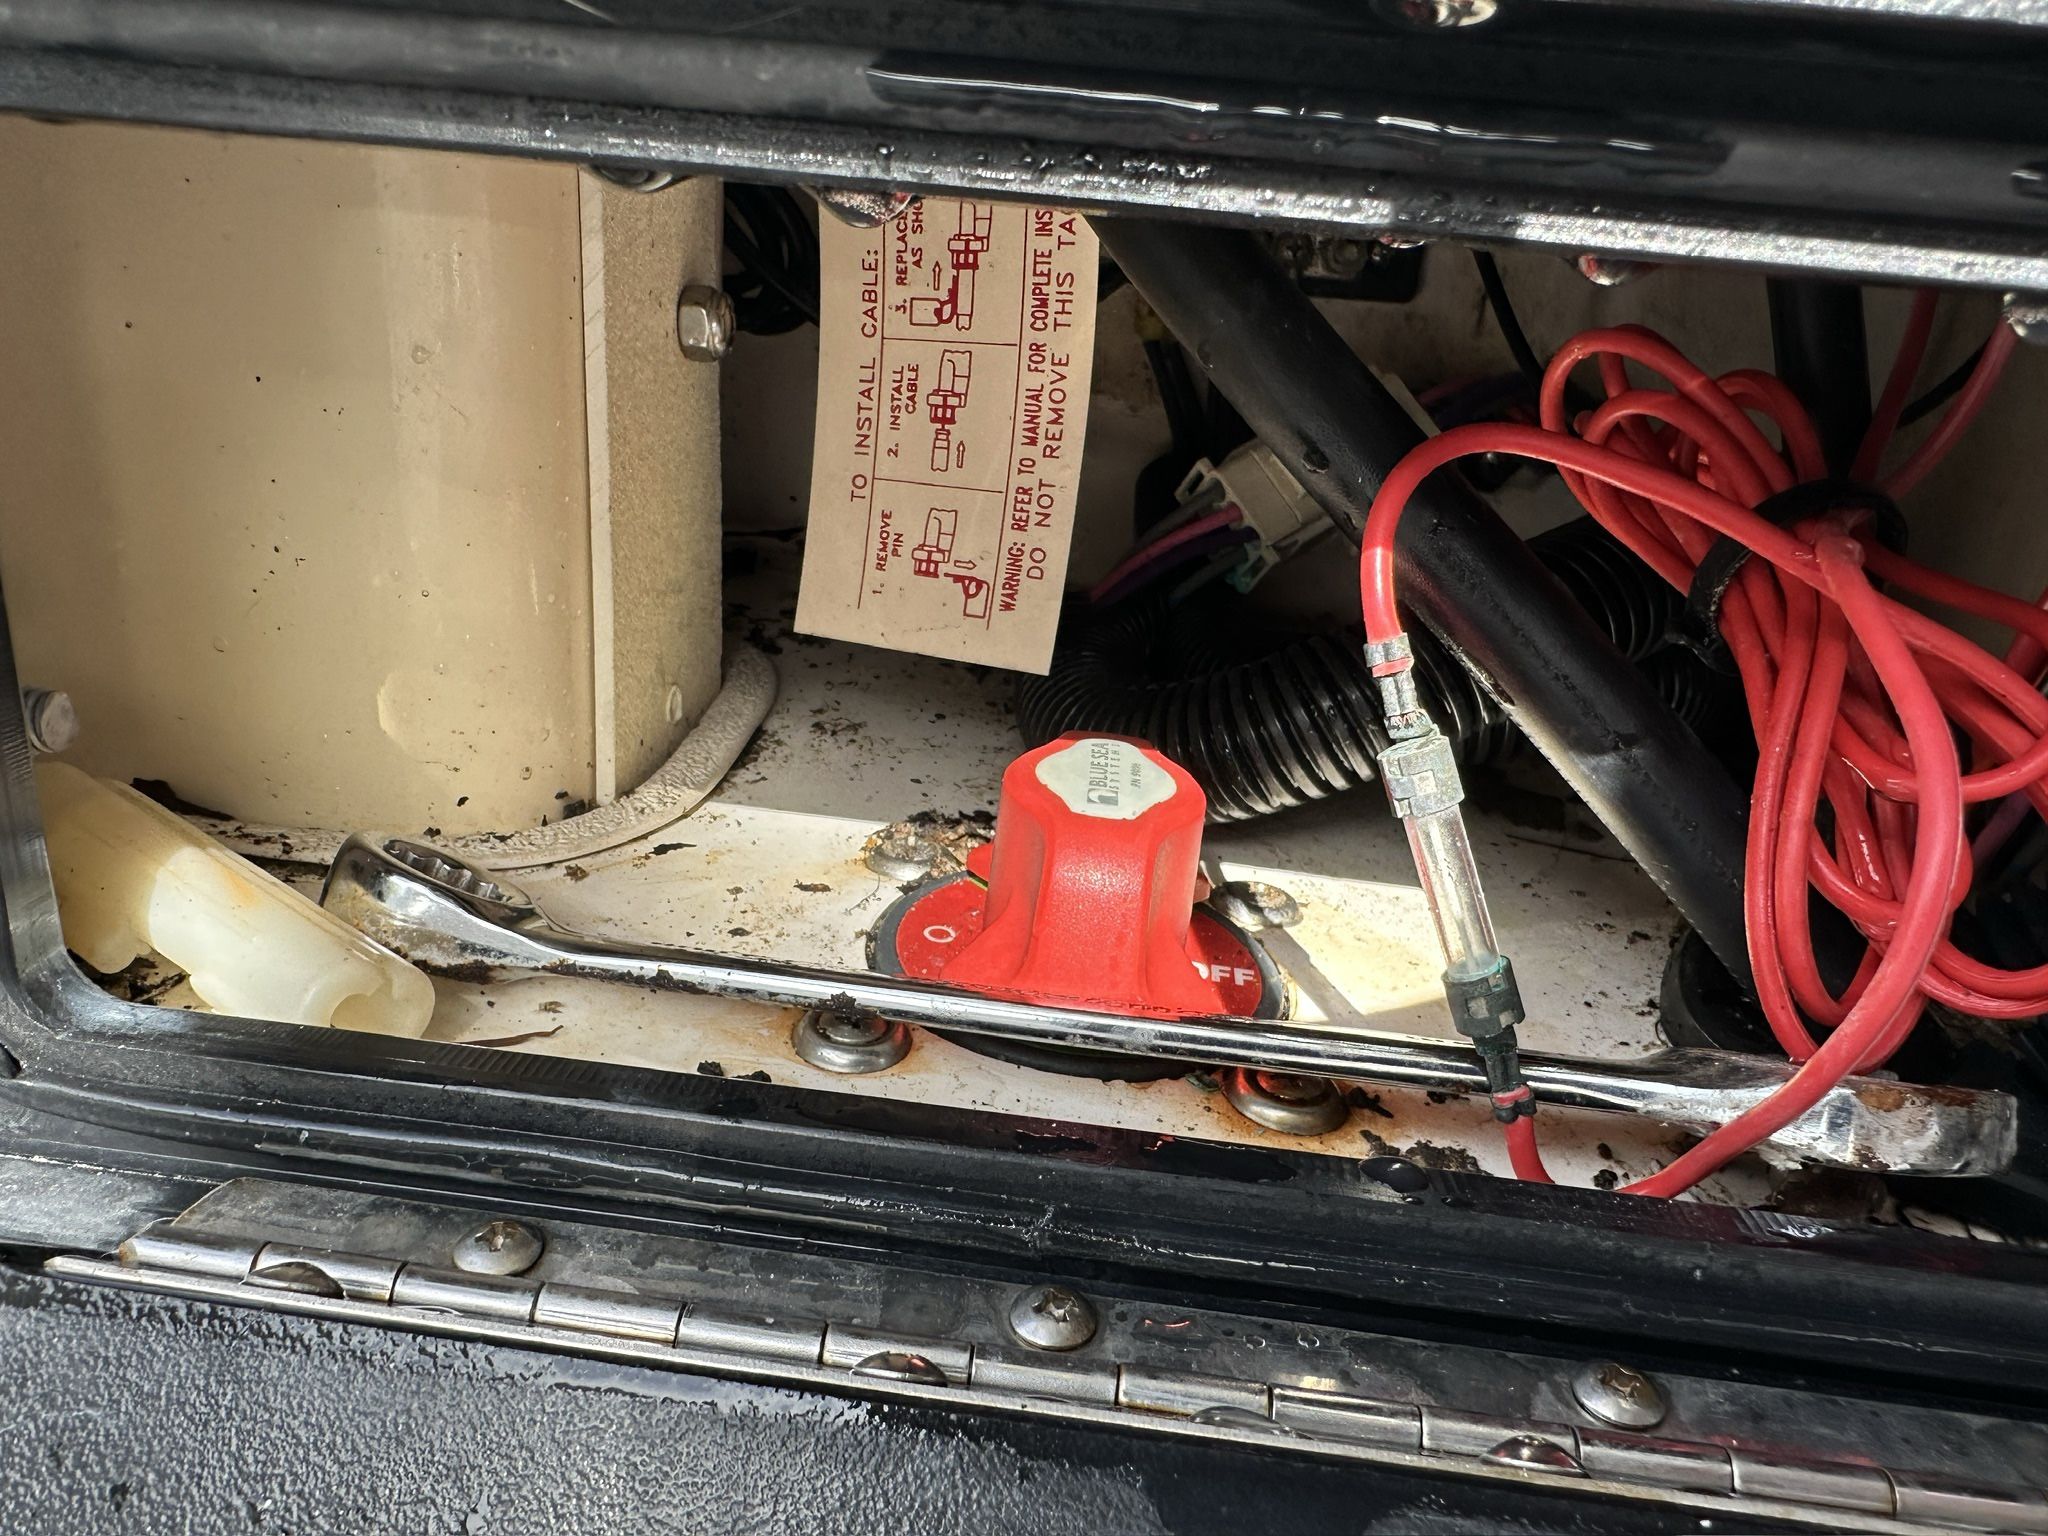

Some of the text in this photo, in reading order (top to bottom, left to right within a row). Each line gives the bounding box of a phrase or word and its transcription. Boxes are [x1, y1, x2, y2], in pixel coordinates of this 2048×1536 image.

[912, 247, 923, 269] AS
[895, 298, 907, 315] 3.
[1030, 249, 1053, 332] COMPLETE
[851, 250, 879, 502] TO INSTALL CABLE:
[1027, 342, 1047, 374] FOR
[888, 366, 905, 458] 2. INSTALL
[905, 364, 919, 414] CABLE
[1026, 211, 1076, 580] DO NOT REMOVE THIS TA
[1021, 383, 1044, 447] MANUAL
[1017, 457, 1036, 476] TO
[1011, 487, 1034, 532] REFER
[872, 509, 893, 595] 1. REMOVE
[892, 533, 904, 558] PIN
[999, 542, 1026, 612] WARNING:
[1089, 761, 1109, 788] BLUE
